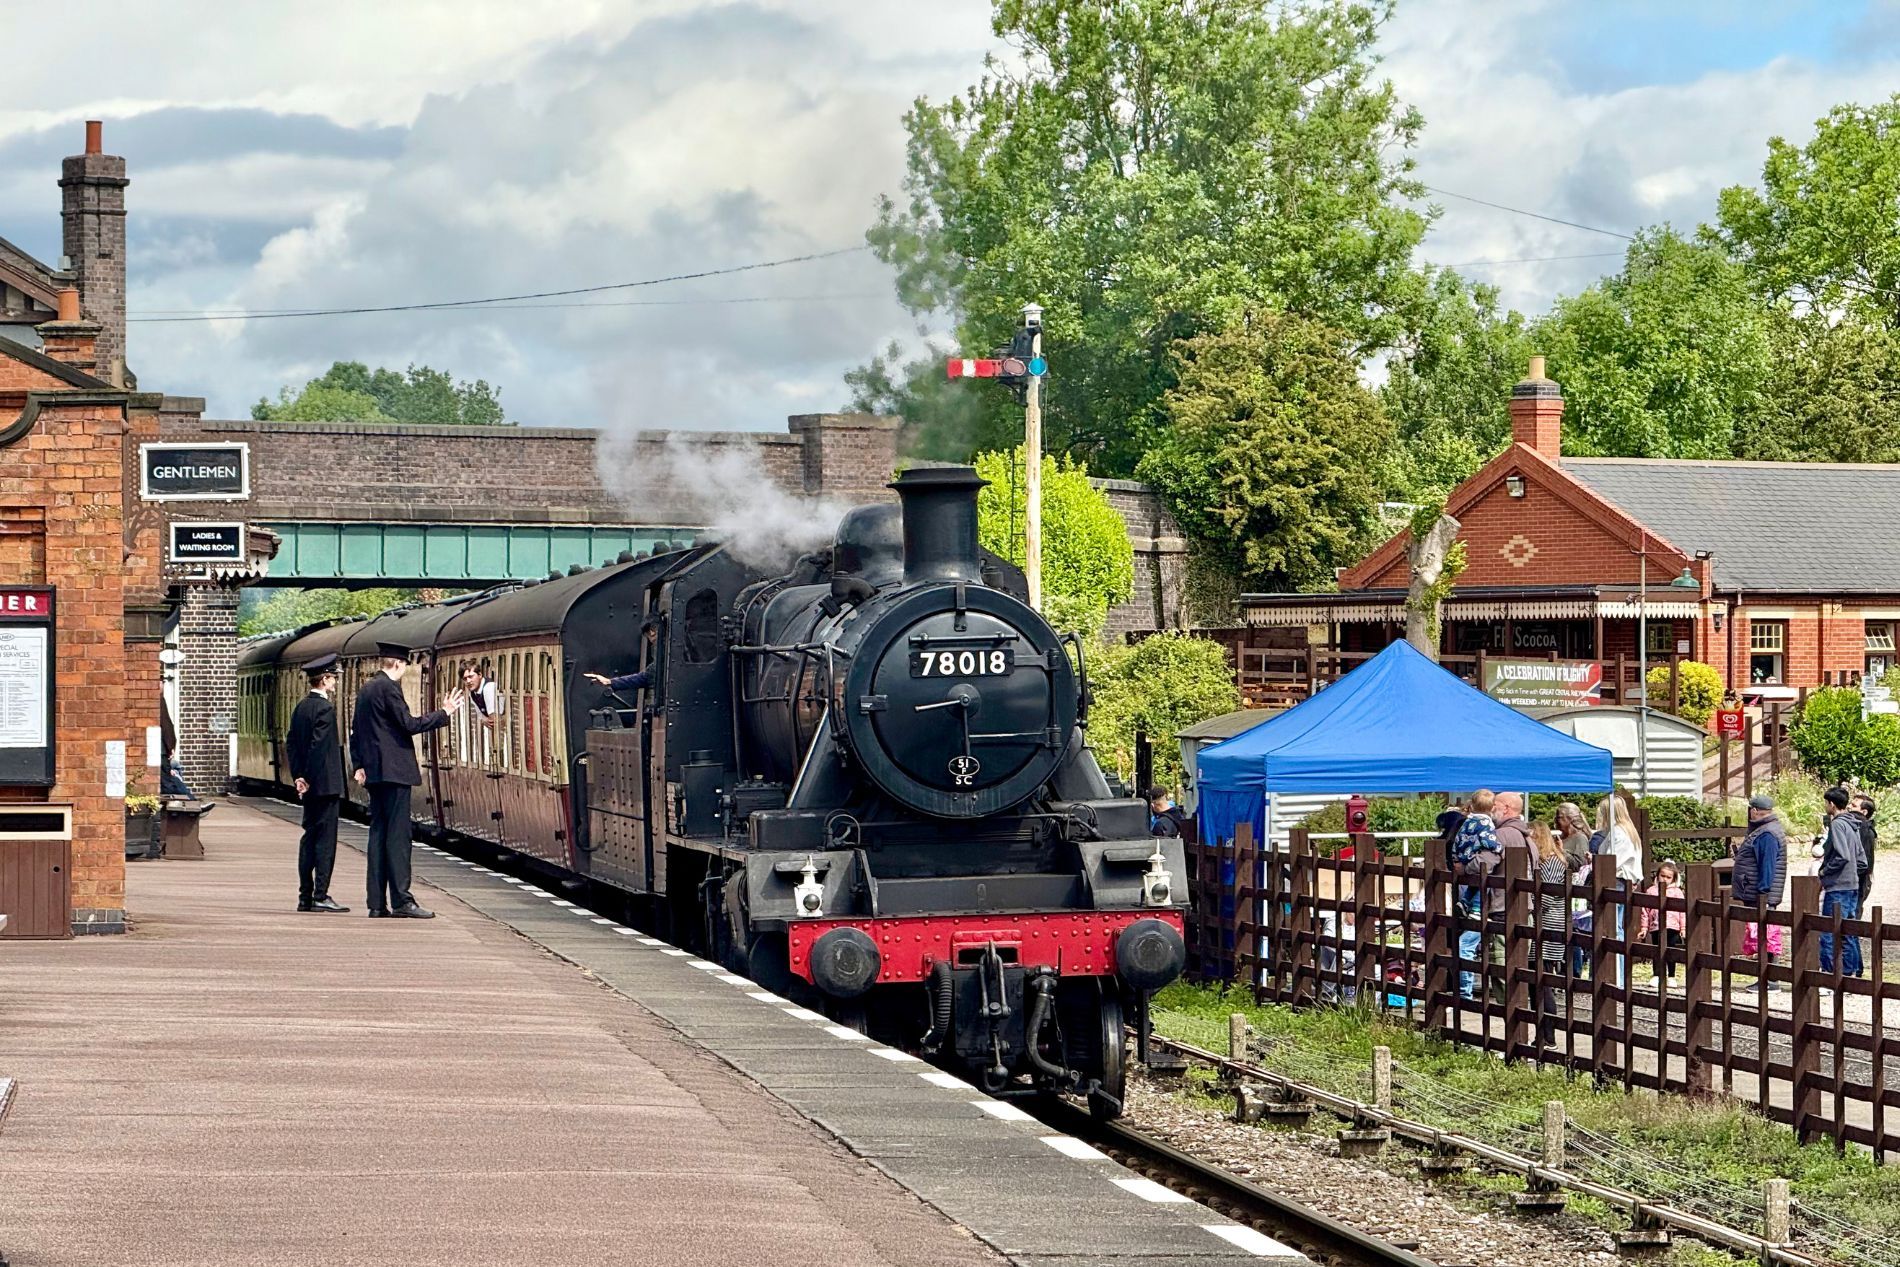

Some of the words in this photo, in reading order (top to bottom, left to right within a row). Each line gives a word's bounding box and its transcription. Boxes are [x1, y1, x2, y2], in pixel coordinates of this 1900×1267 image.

[153, 466, 236, 478] GENTLEMEN
[192, 532, 215, 540] LADIES
[216, 532, 222, 540] &
[1523, 634, 1557, 648] COCOA
[920, 651, 1006, 676] 78018
[1496, 665, 1502, 680] A
[1503, 665, 1556, 681] CELEBRATION
[1563, 667, 1590, 683] BLIGHTY
[1519, 687, 1529, 695] Time
[1511, 698, 1537, 706] WEEKEND
[958, 758, 969, 768] 51
[961, 767, 967, 775] F
[955, 775, 973, 785] SC
